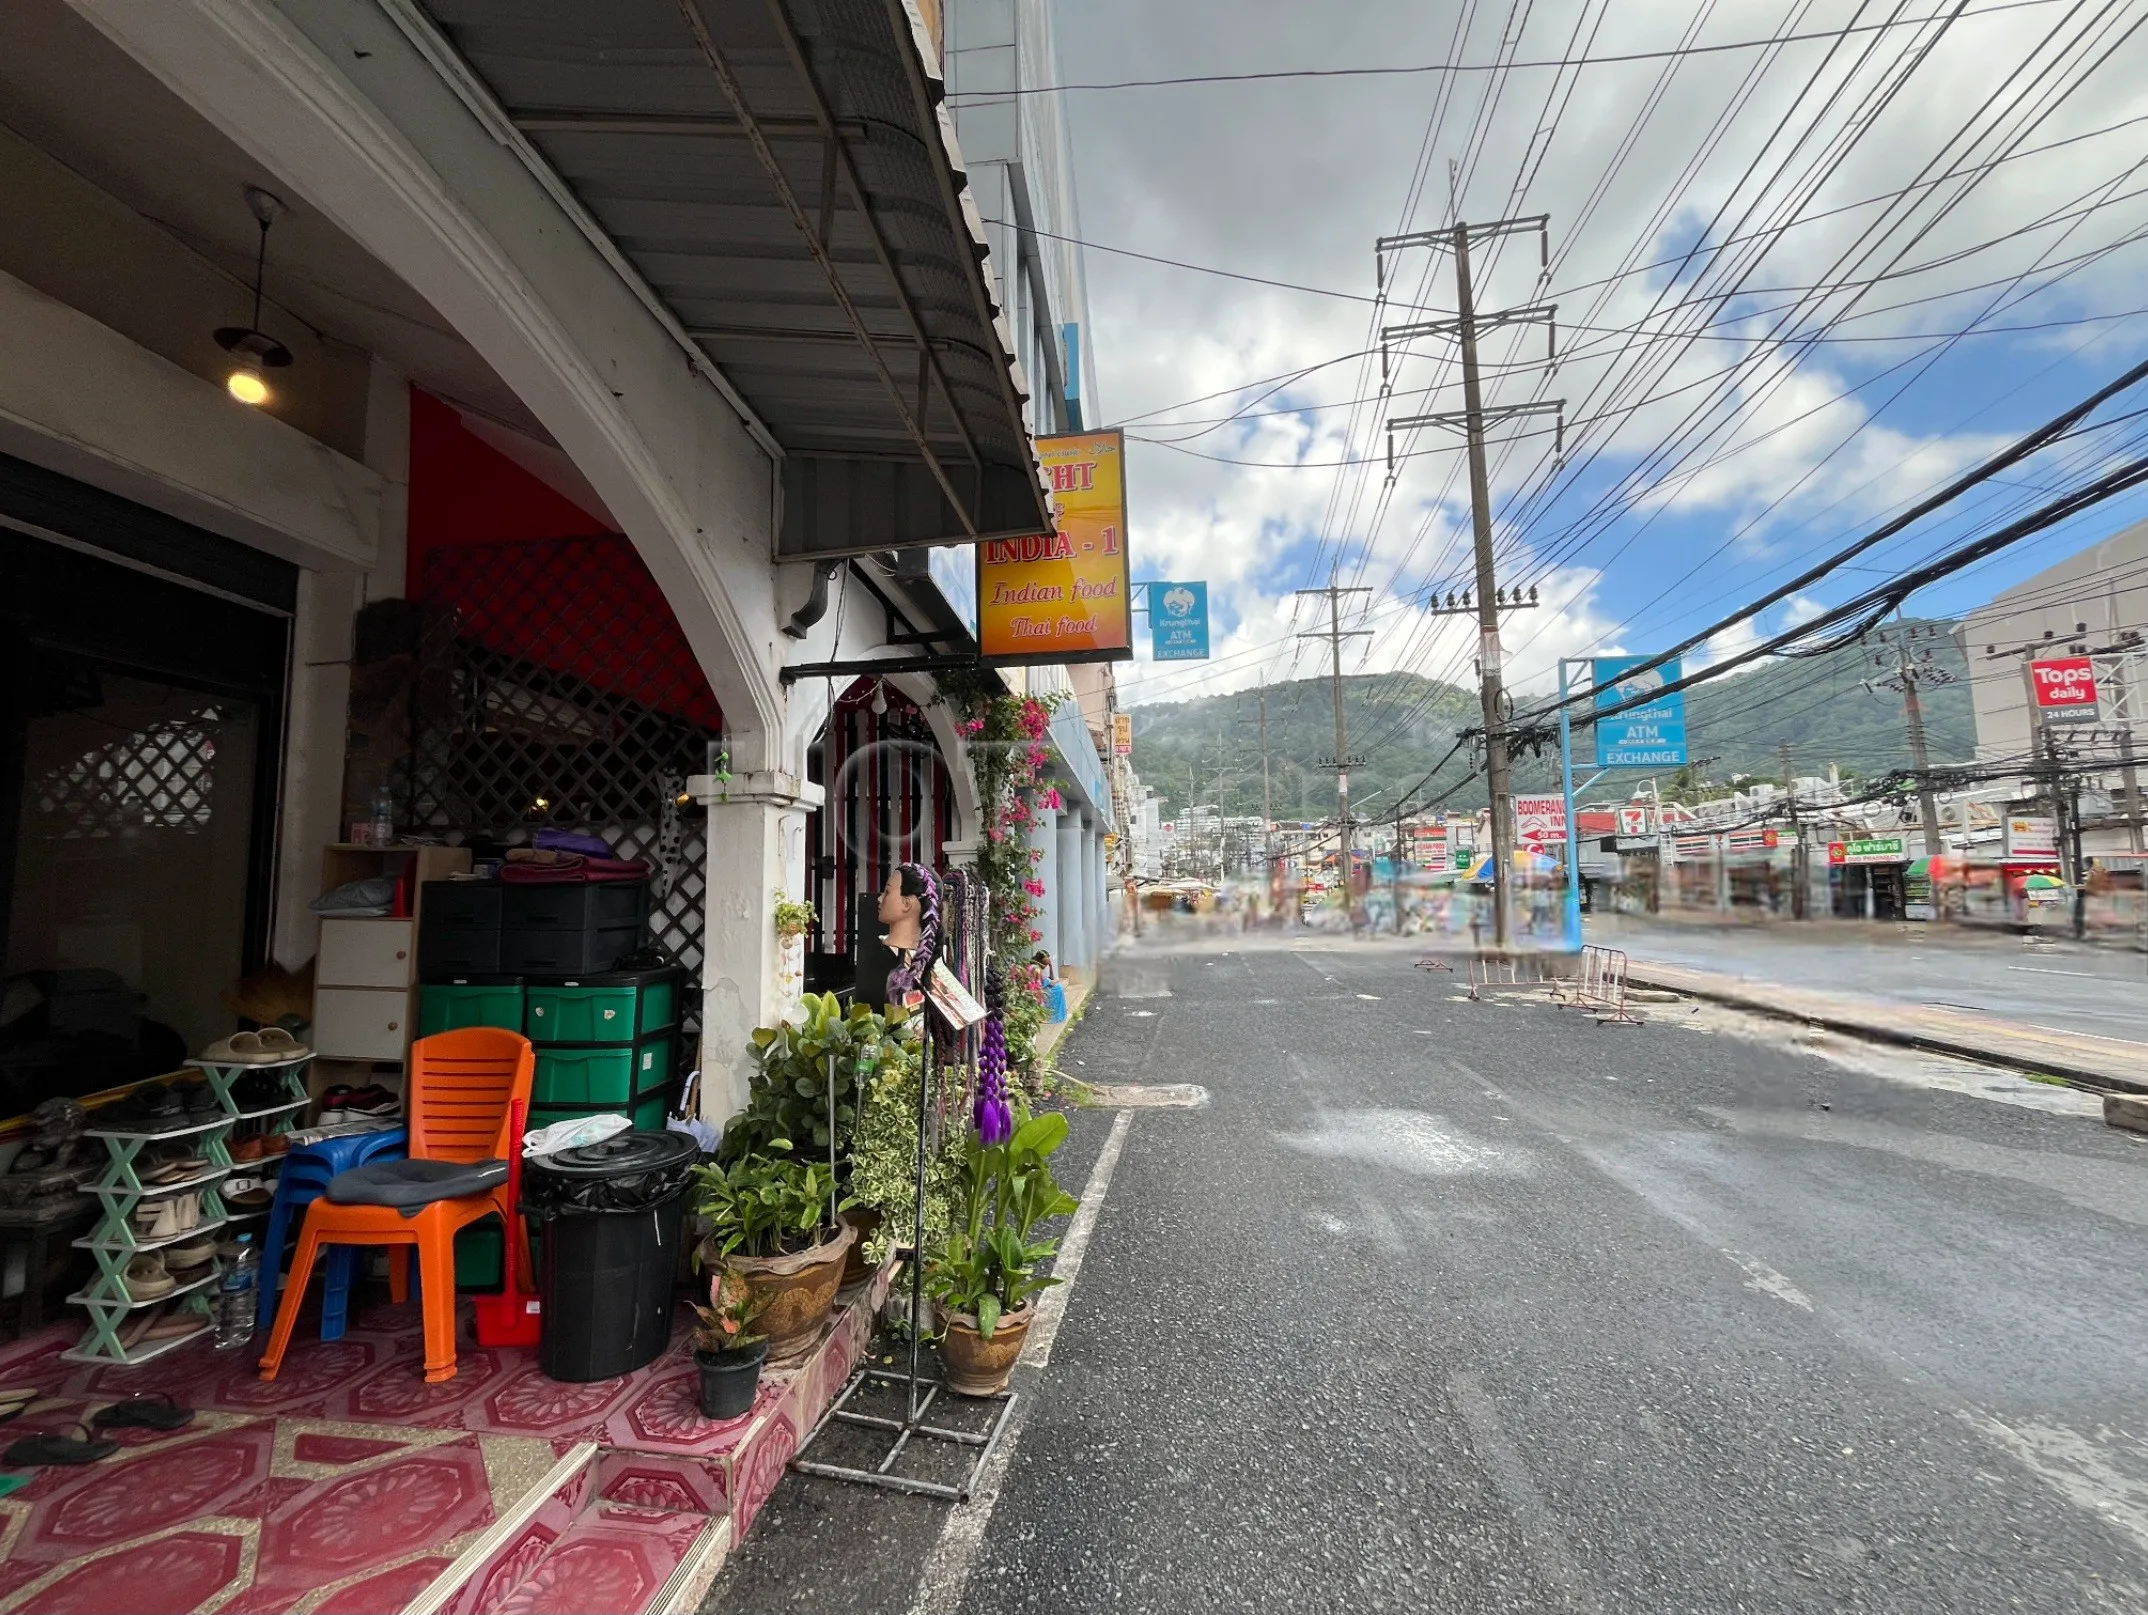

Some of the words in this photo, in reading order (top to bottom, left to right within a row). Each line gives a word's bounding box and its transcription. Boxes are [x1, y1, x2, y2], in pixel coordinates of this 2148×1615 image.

[986, 530, 1076, 564] INDIA
[1101, 525, 1119, 556] 1
[990, 581, 1064, 606] Indian
[1070, 576, 1118, 604] food
[1010, 616, 1051, 638] Thai
[1055, 613, 1098, 638] food
[1170, 630, 1192, 640] ATM
[1157, 648, 1206, 658] EXCHANGE
[2034, 667, 2092, 686] Tops
[2049, 686, 2086, 700] daily
[2046, 711, 2059, 719] 24
[2061, 708, 2095, 718] HOURS
[1626, 725, 1659, 738] ATM
[1607, 750, 1680, 764] EXCHANGE
